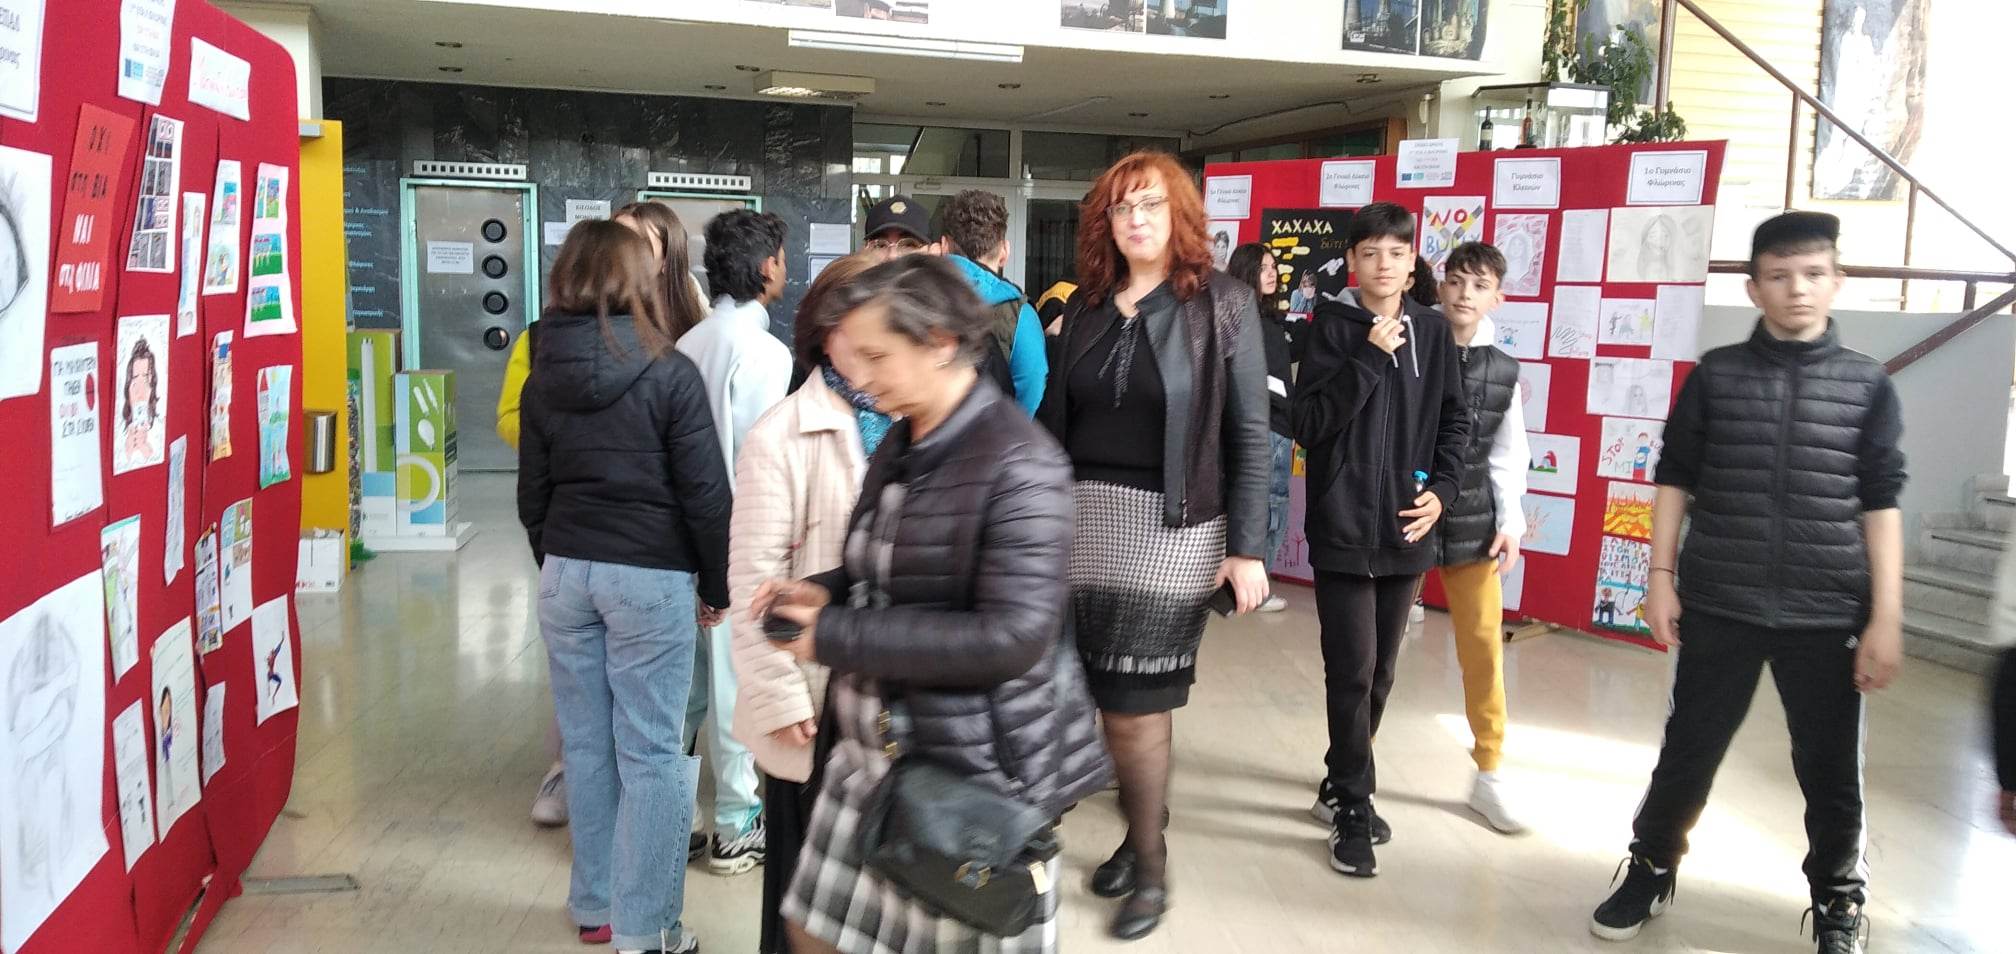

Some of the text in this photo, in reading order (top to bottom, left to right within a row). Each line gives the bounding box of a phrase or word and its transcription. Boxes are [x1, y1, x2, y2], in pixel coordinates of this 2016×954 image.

[1655, 166, 1692, 175] Γυμνάσιο
[1511, 172, 1544, 180] Γυμνάσιο
[1647, 178, 1687, 187] Φλώρινας
[1430, 208, 1468, 226] NO
[1271, 218, 1334, 235] ΧΑΧΑΧΑ
